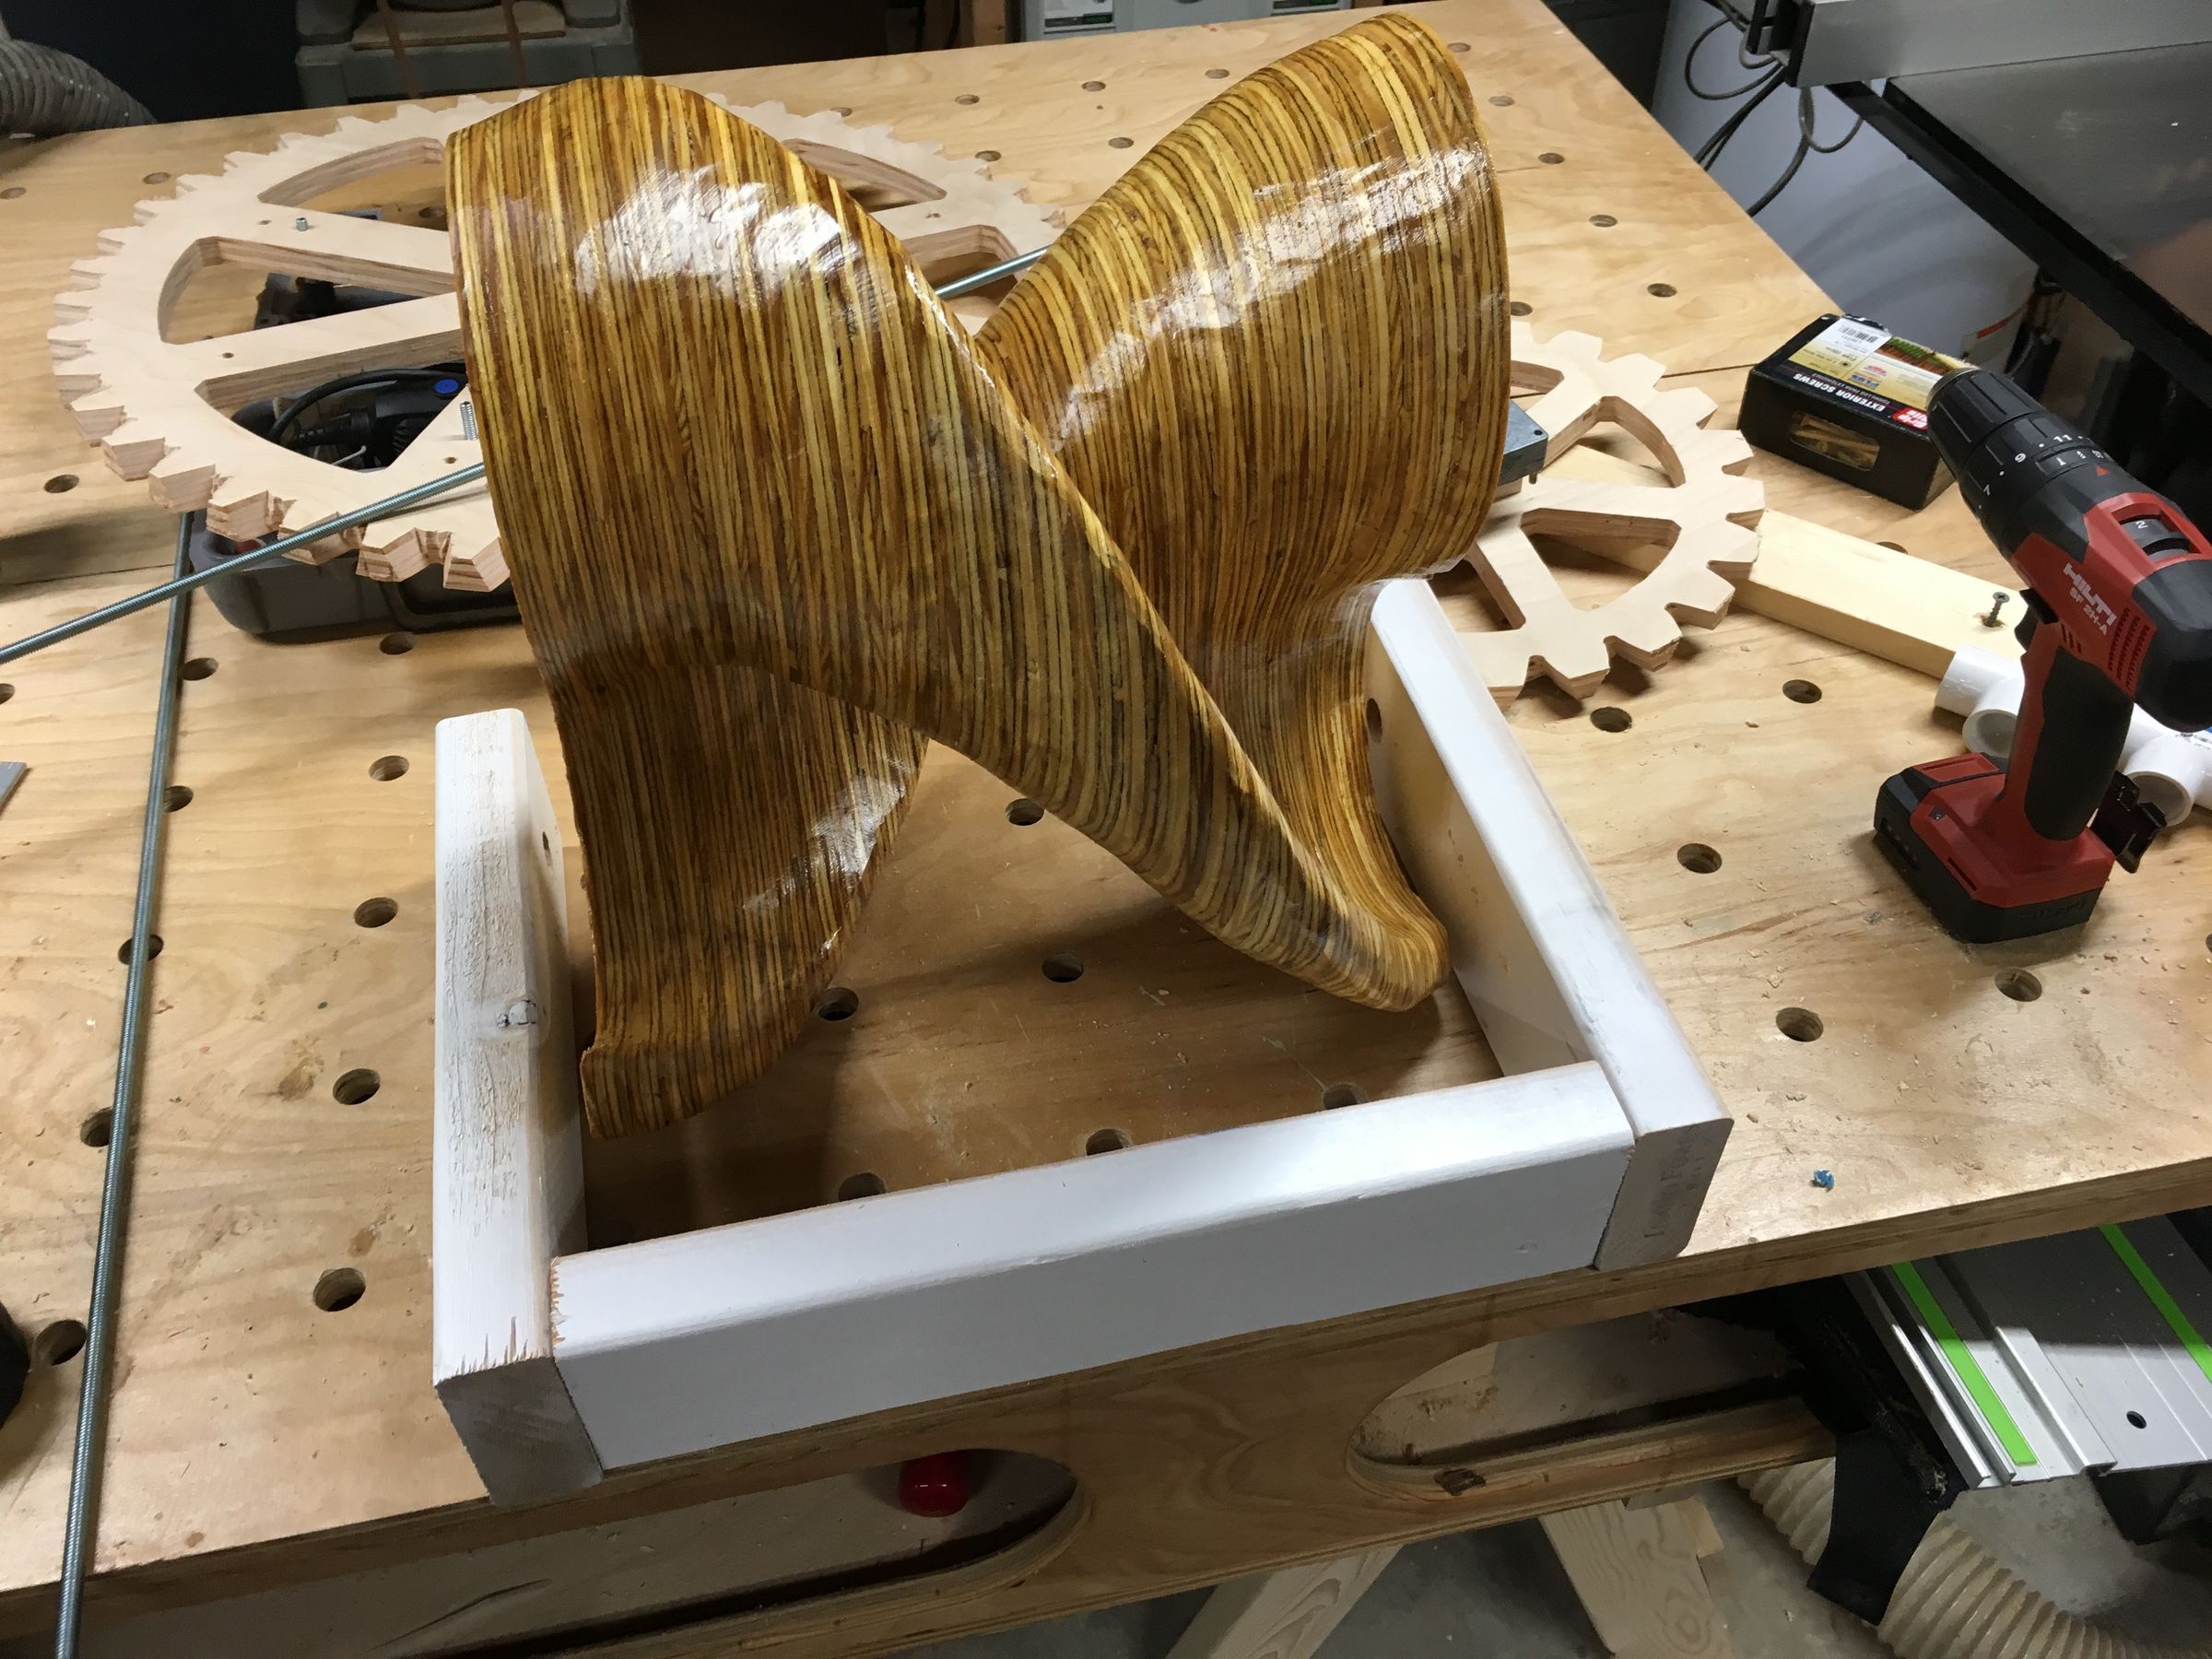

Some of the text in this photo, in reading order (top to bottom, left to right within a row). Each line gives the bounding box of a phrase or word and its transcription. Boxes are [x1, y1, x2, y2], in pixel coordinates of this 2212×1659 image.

[1793, 372, 1886, 412] EXTERIOR SCREWS
[2053, 434, 2072, 442] 11
[2136, 520, 2148, 529] 2
[2063, 562, 2117, 626] HILTI
[2069, 587, 2084, 604] SF
